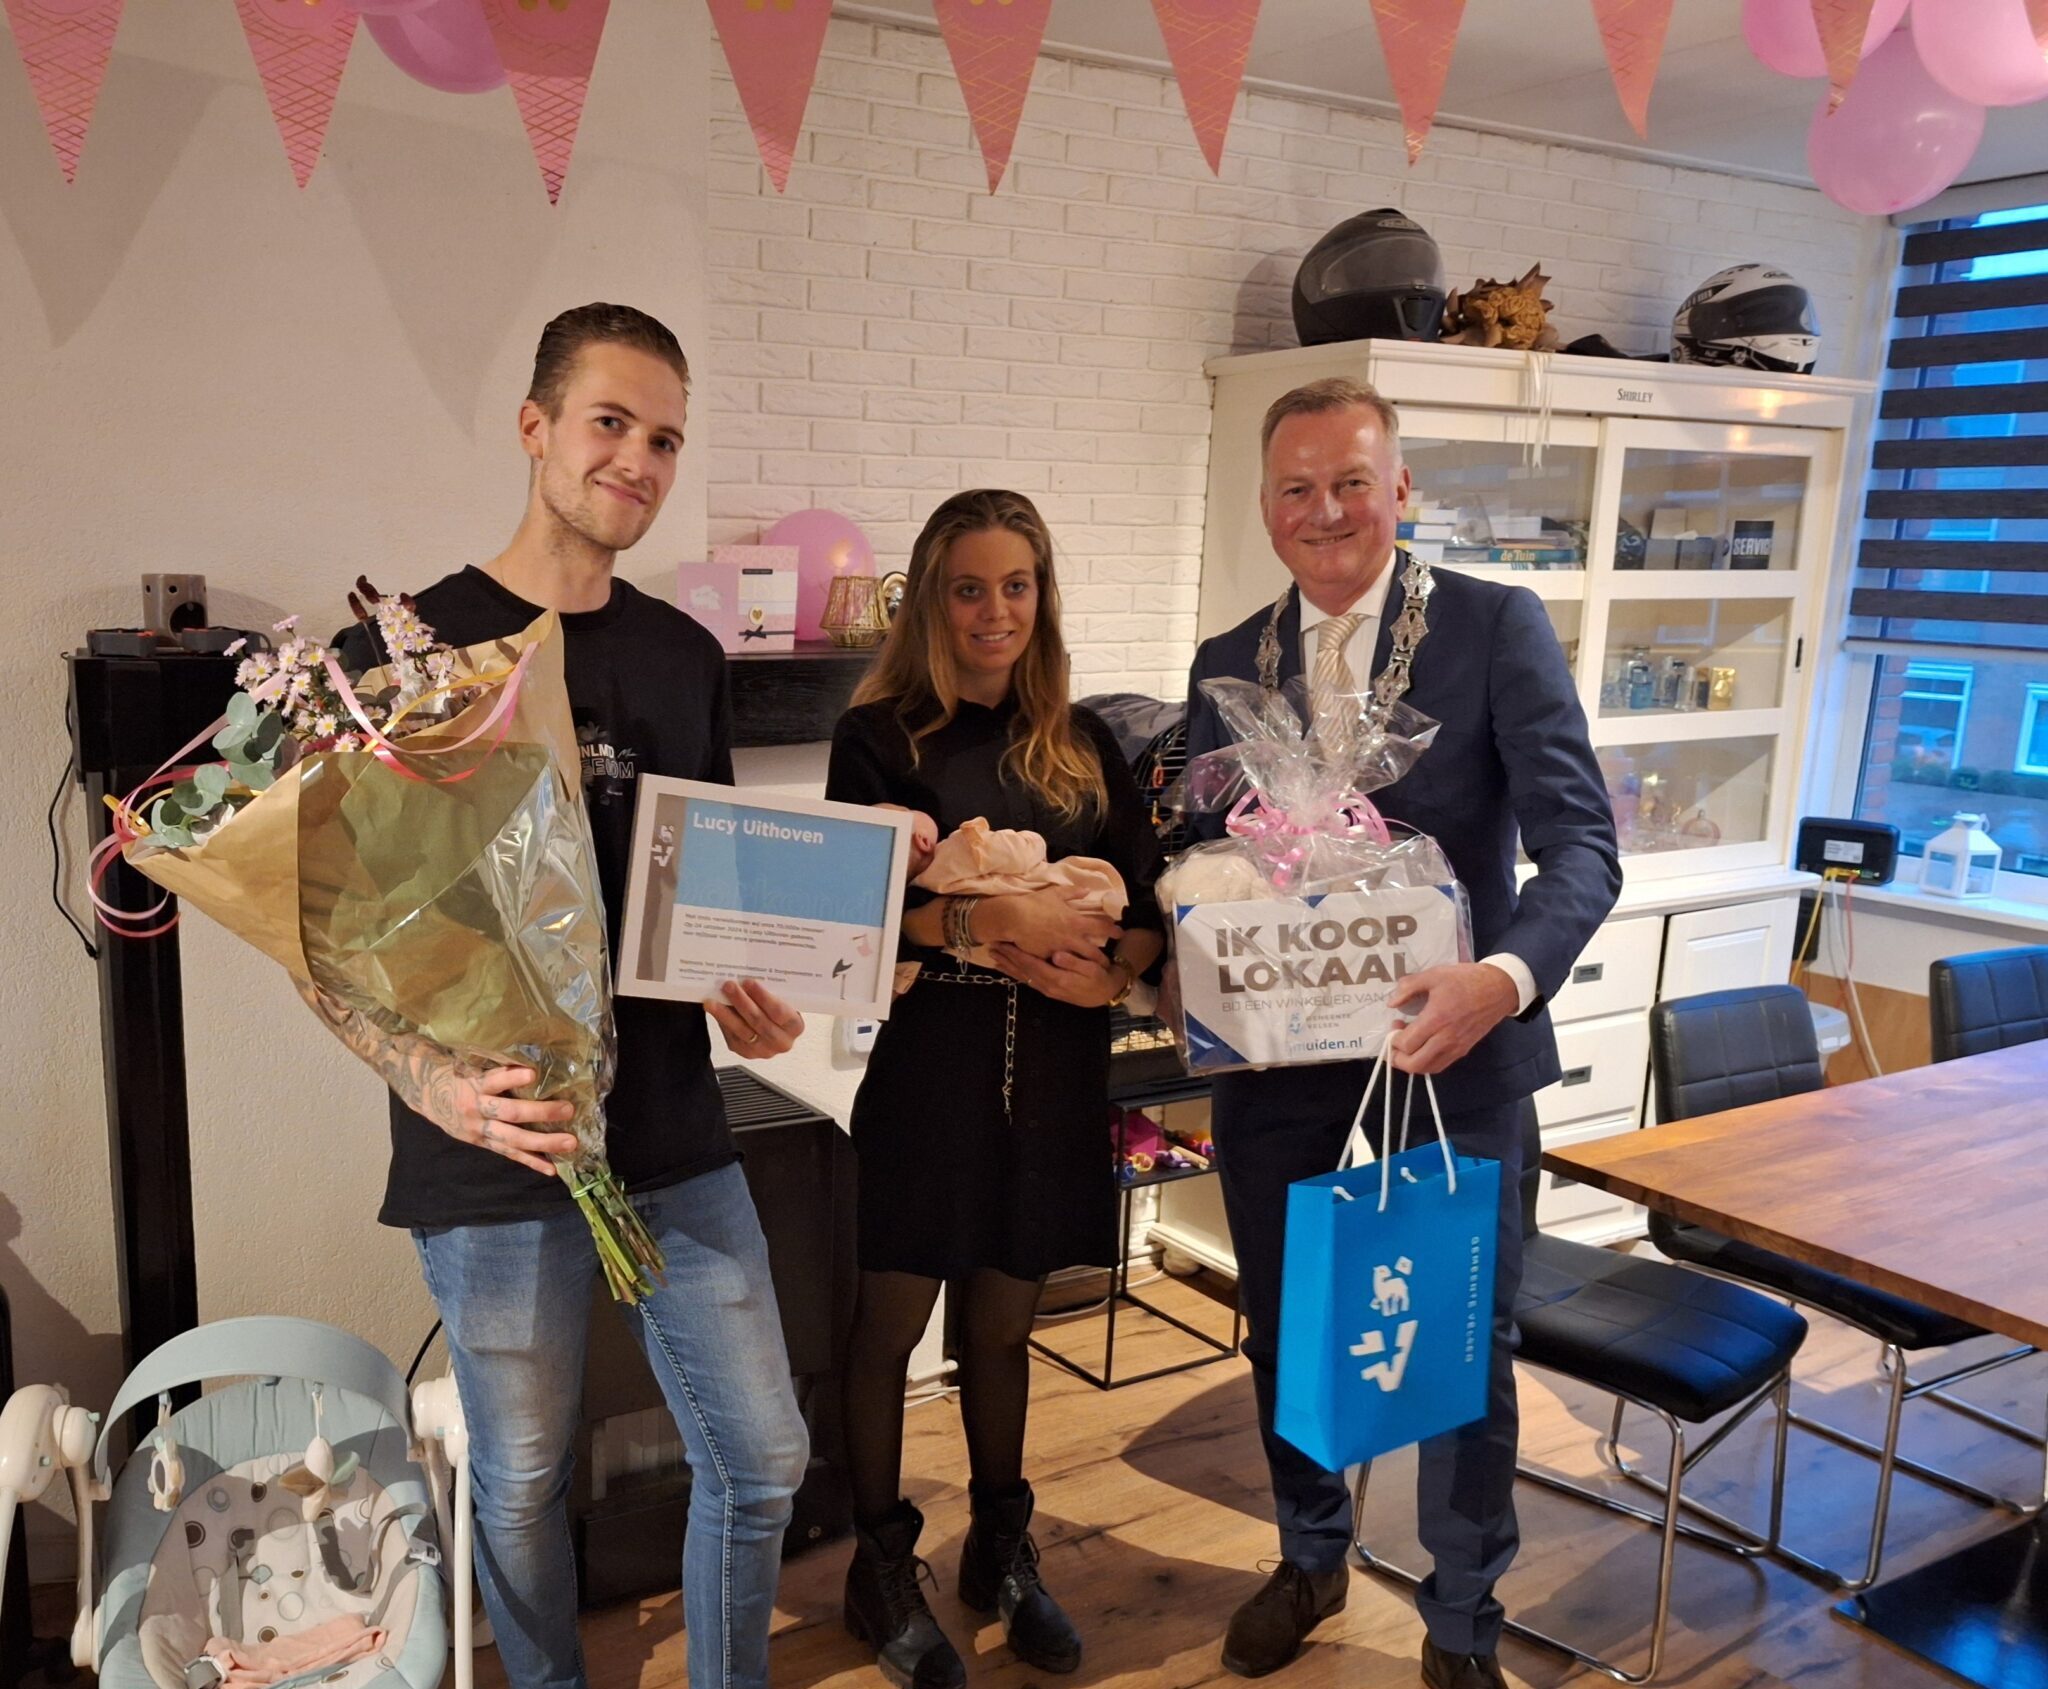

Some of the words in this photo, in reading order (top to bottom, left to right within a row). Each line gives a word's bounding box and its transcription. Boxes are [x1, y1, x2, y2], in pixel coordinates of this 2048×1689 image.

[1501, 549, 1513, 561] de
[1514, 549, 1536, 561] Tuin
[693, 812, 737, 835] Lucy
[743, 819, 824, 844] Uithoven
[1216, 925, 1263, 957] IK
[1277, 914, 1418, 954] KOOP
[1218, 952, 1411, 994] LOKAAL
[1245, 999, 1272, 1011] EEN
[1276, 994, 1351, 1009] WINKELIER
[1354, 992, 1384, 1003] VAN
